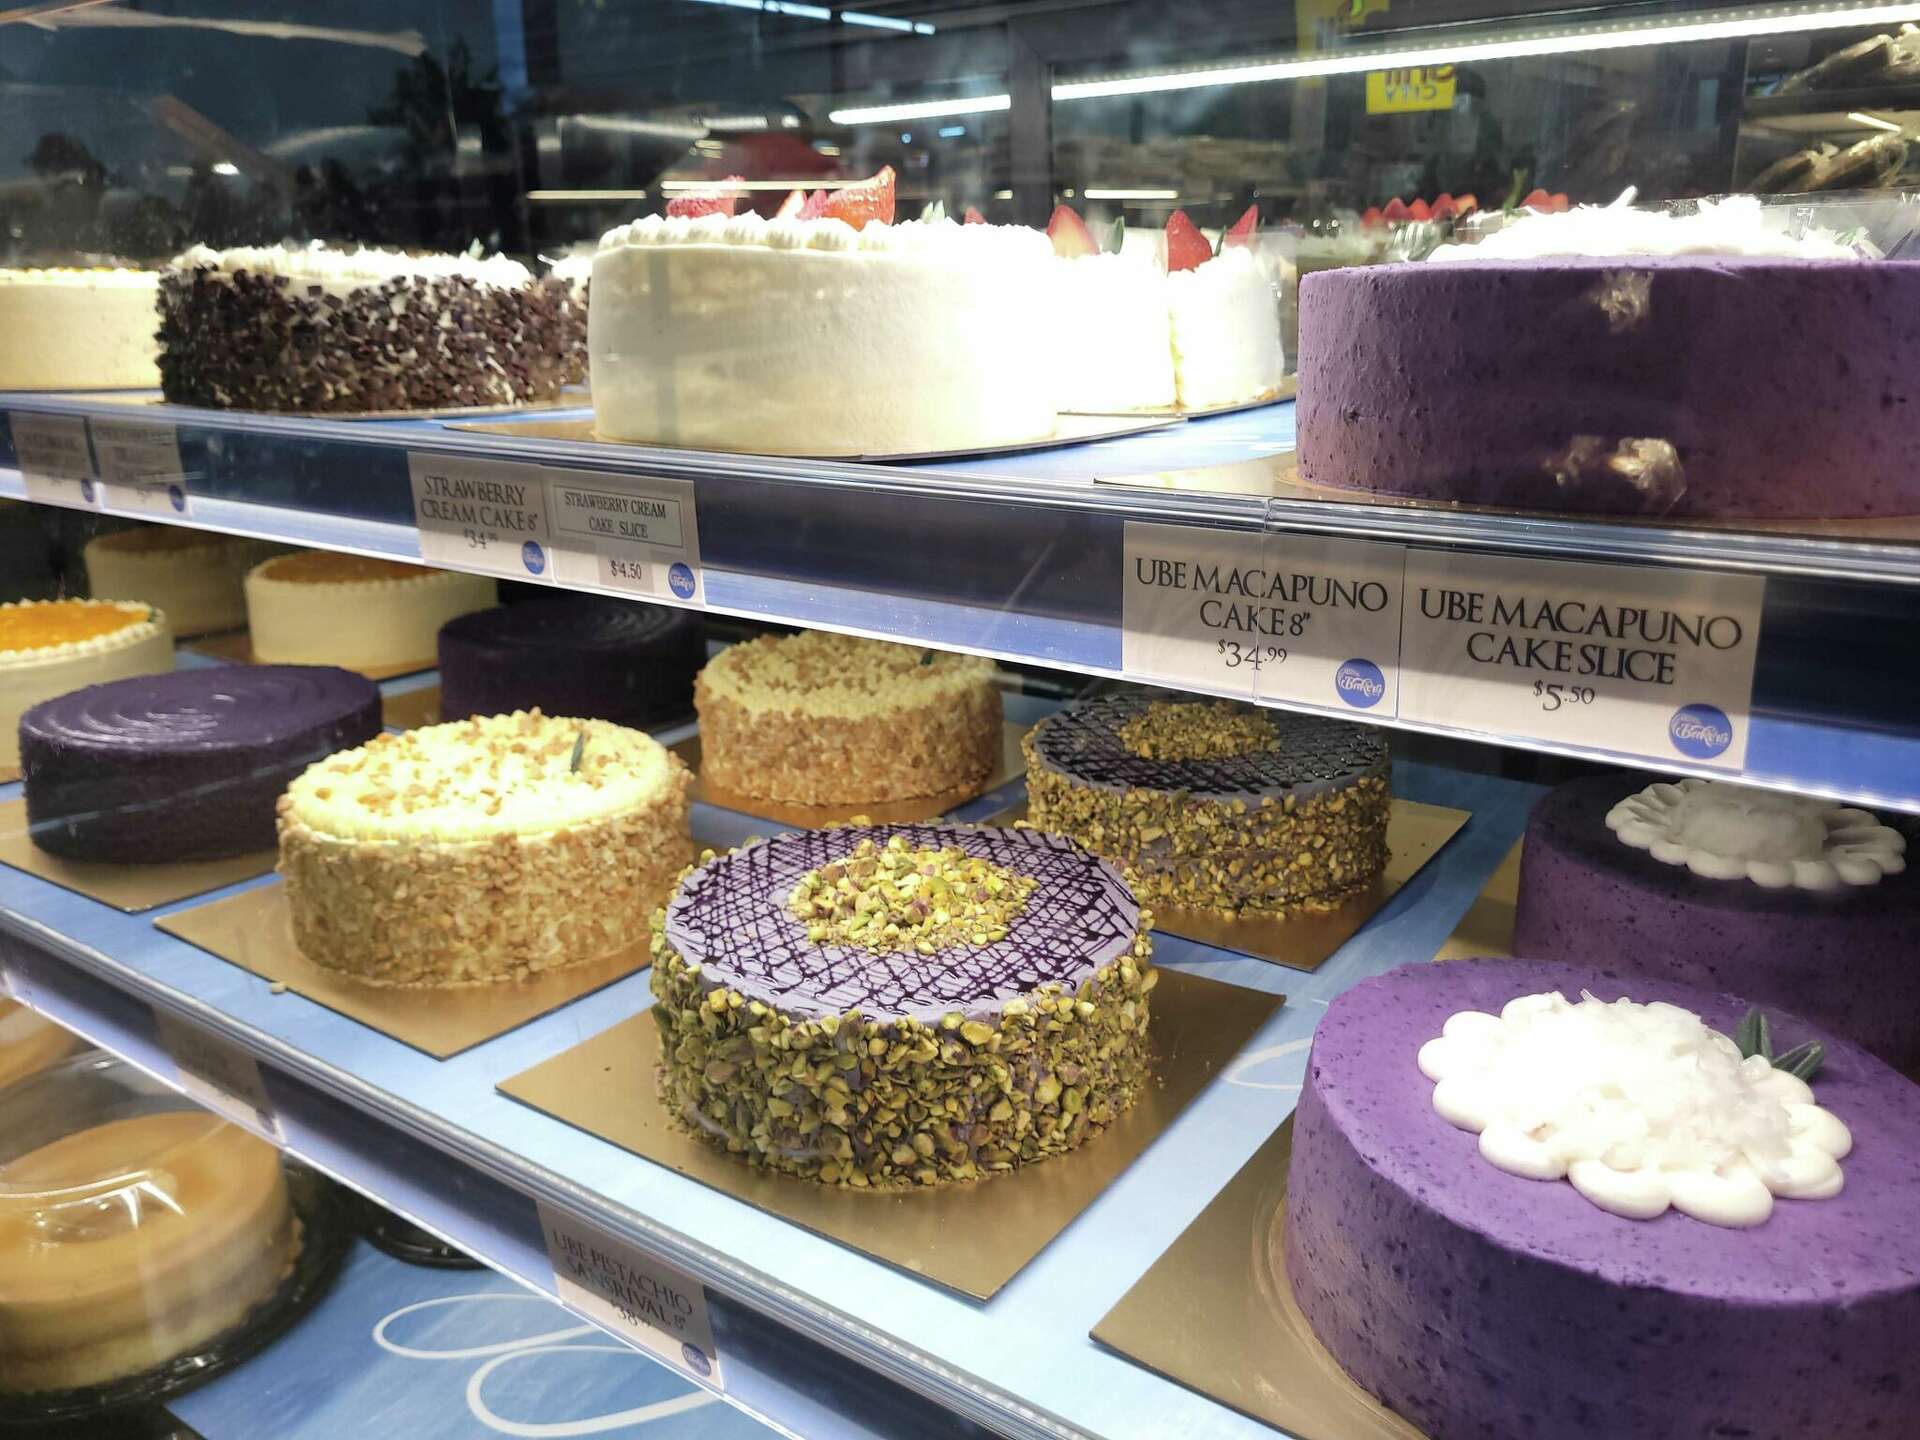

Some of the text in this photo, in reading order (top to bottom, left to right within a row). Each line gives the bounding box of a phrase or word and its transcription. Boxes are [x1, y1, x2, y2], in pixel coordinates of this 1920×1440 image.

[424, 476, 526, 506] STRAWBERRY
[564, 492, 667, 519] STRAWBERRY CREAM
[421, 499, 478, 525] CREAM
[480, 506, 525, 531] CAKE
[588, 516, 648, 539] CAKE SLICE
[611, 560, 642, 580] $4.50
[1135, 557, 1389, 612] UBE MACAPUNO
[1200, 600, 1284, 636] CAKE
[1419, 588, 1743, 650] UBE MACAPUNO
[1217, 638, 1288, 671] $34.99
[1466, 632, 1676, 686] CAKE SLICE
[1533, 679, 1596, 712] $5.50
[554, 1229, 692, 1315] UBE PISTACHIO
